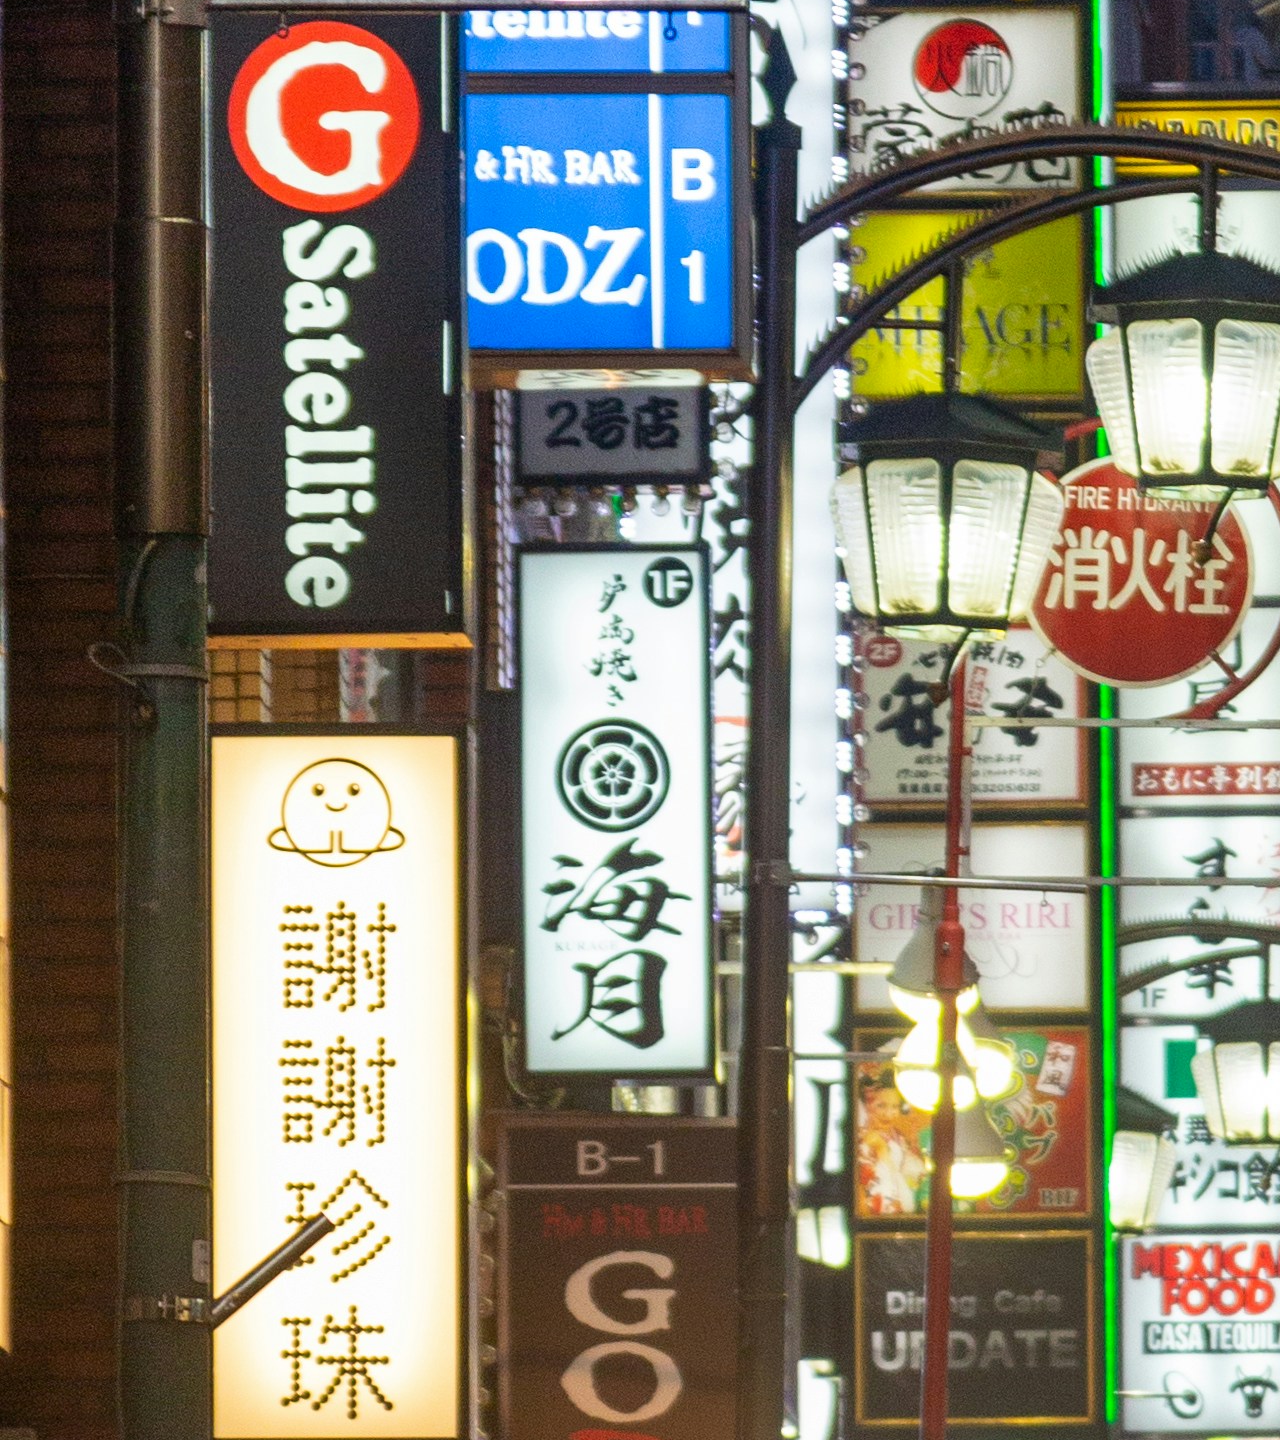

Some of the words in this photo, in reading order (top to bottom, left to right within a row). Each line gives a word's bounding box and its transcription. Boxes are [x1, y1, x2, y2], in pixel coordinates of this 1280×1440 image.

[246, 41, 391, 196] G
[565, 148, 640, 184] BAR
[282, 220, 377, 608] Satellite
[545, 398, 680, 451] 2号店
[1064, 487, 1111, 511] FIRE
[648, 568, 690, 597] 1F
[1045, 527, 1232, 615] 消火栓
[1000, 901, 1072, 930] RIRI
[539, 836, 695, 1050] 海月
[1140, 988, 1167, 1008] 1F
[278, 902, 396, 1418] 謝謝珍珠
[576, 1140, 667, 1177] B-1
[1160, 1278, 1276, 1316] FOOD
[1147, 1323, 1203, 1351] CASA
